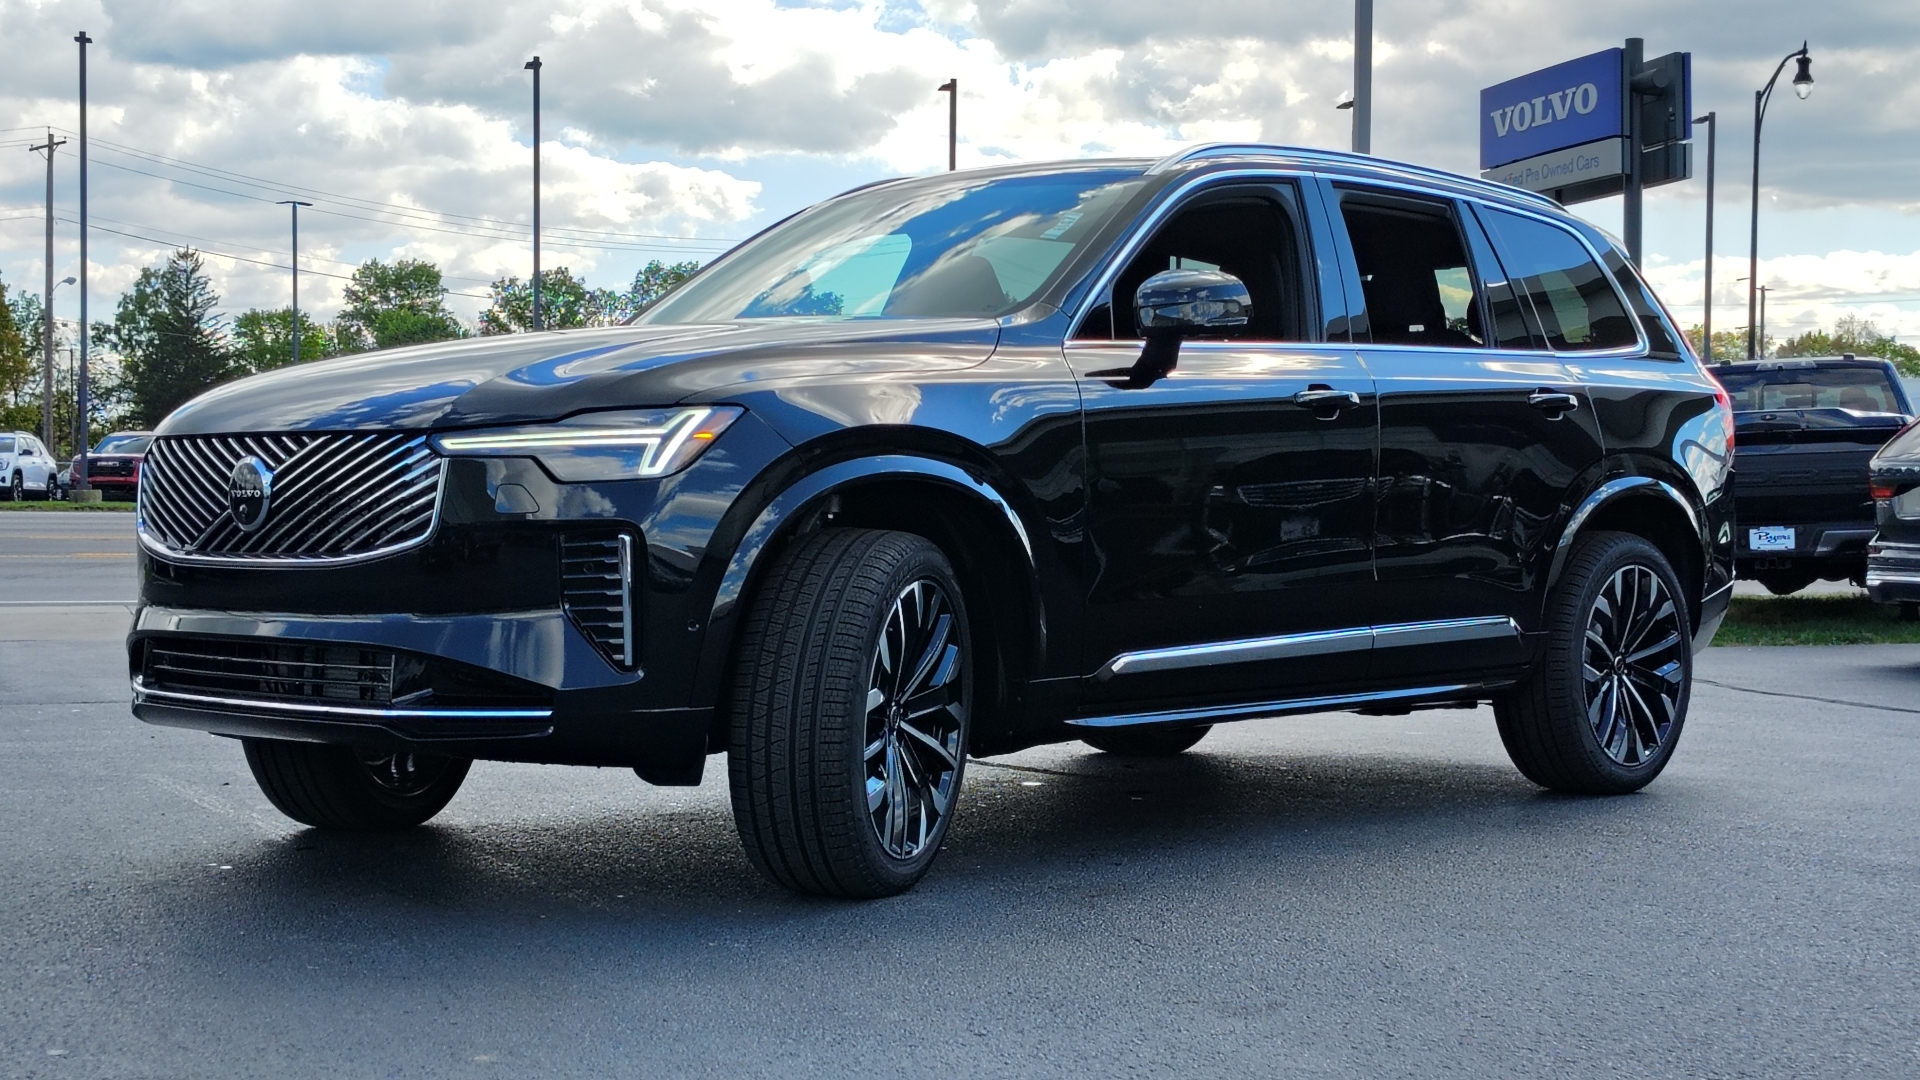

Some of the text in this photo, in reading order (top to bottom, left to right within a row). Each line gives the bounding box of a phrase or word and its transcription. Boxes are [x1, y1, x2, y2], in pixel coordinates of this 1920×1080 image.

[1490, 83, 1598, 138] VOLVO
[1525, 168, 1540, 184] Pre
[1541, 158, 1574, 179] Owned
[1576, 155, 1600, 171] Cars
[231, 489, 261, 498] VOLVO
